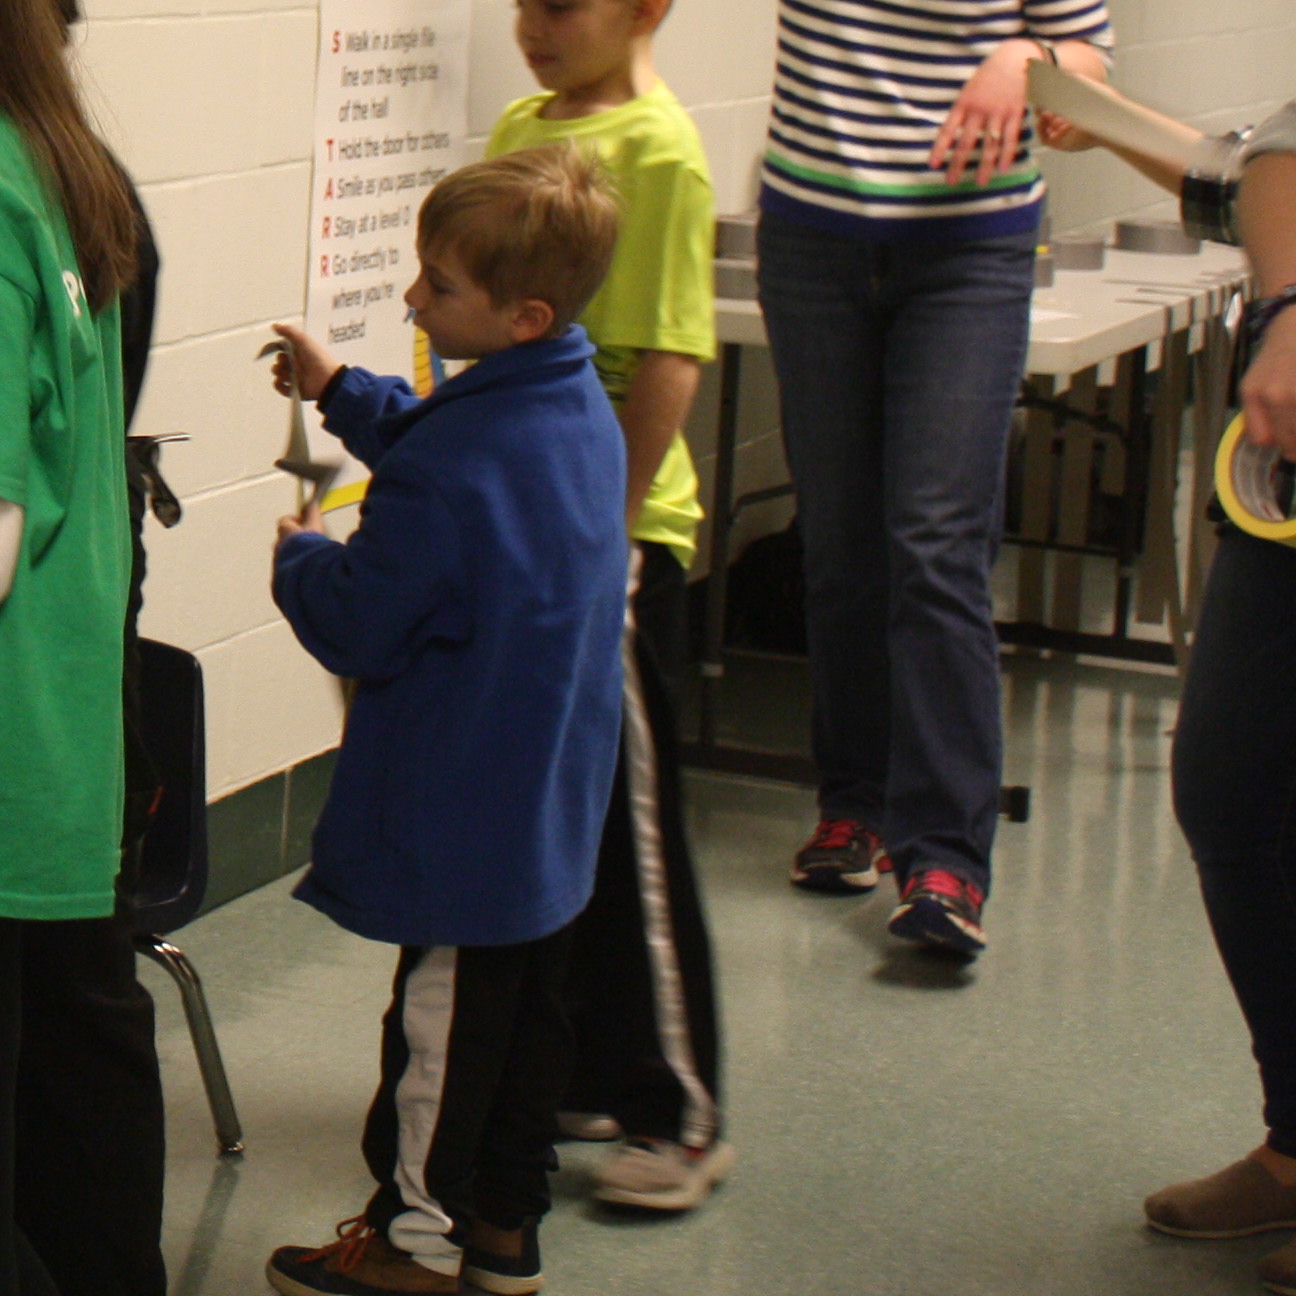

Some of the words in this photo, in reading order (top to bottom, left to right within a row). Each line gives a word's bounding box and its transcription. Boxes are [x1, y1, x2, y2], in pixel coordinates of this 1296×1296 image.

[331, 30, 341, 54] S
[345, 30, 369, 53] Walk
[340, 65, 360, 88] line
[375, 63, 392, 85] the
[393, 62, 418, 88] right
[338, 99, 351, 123] of
[352, 98, 368, 121] the
[325, 138, 335, 162] T
[338, 136, 362, 161] Hold
[363, 135, 379, 158] the
[381, 132, 404, 156] door
[323, 177, 334, 201] A
[337, 174, 364, 200] Smile
[321, 215, 331, 239] R
[334, 215, 356, 240] Stay
[357, 213, 368, 234] at
[379, 206, 402, 230] level
[320, 253, 329, 277] R
[332, 253, 348, 276] Go
[349, 247, 386, 272] directly
[387, 246, 400, 266] to
[331, 287, 362, 310] where
[327, 315, 366, 345] headed
